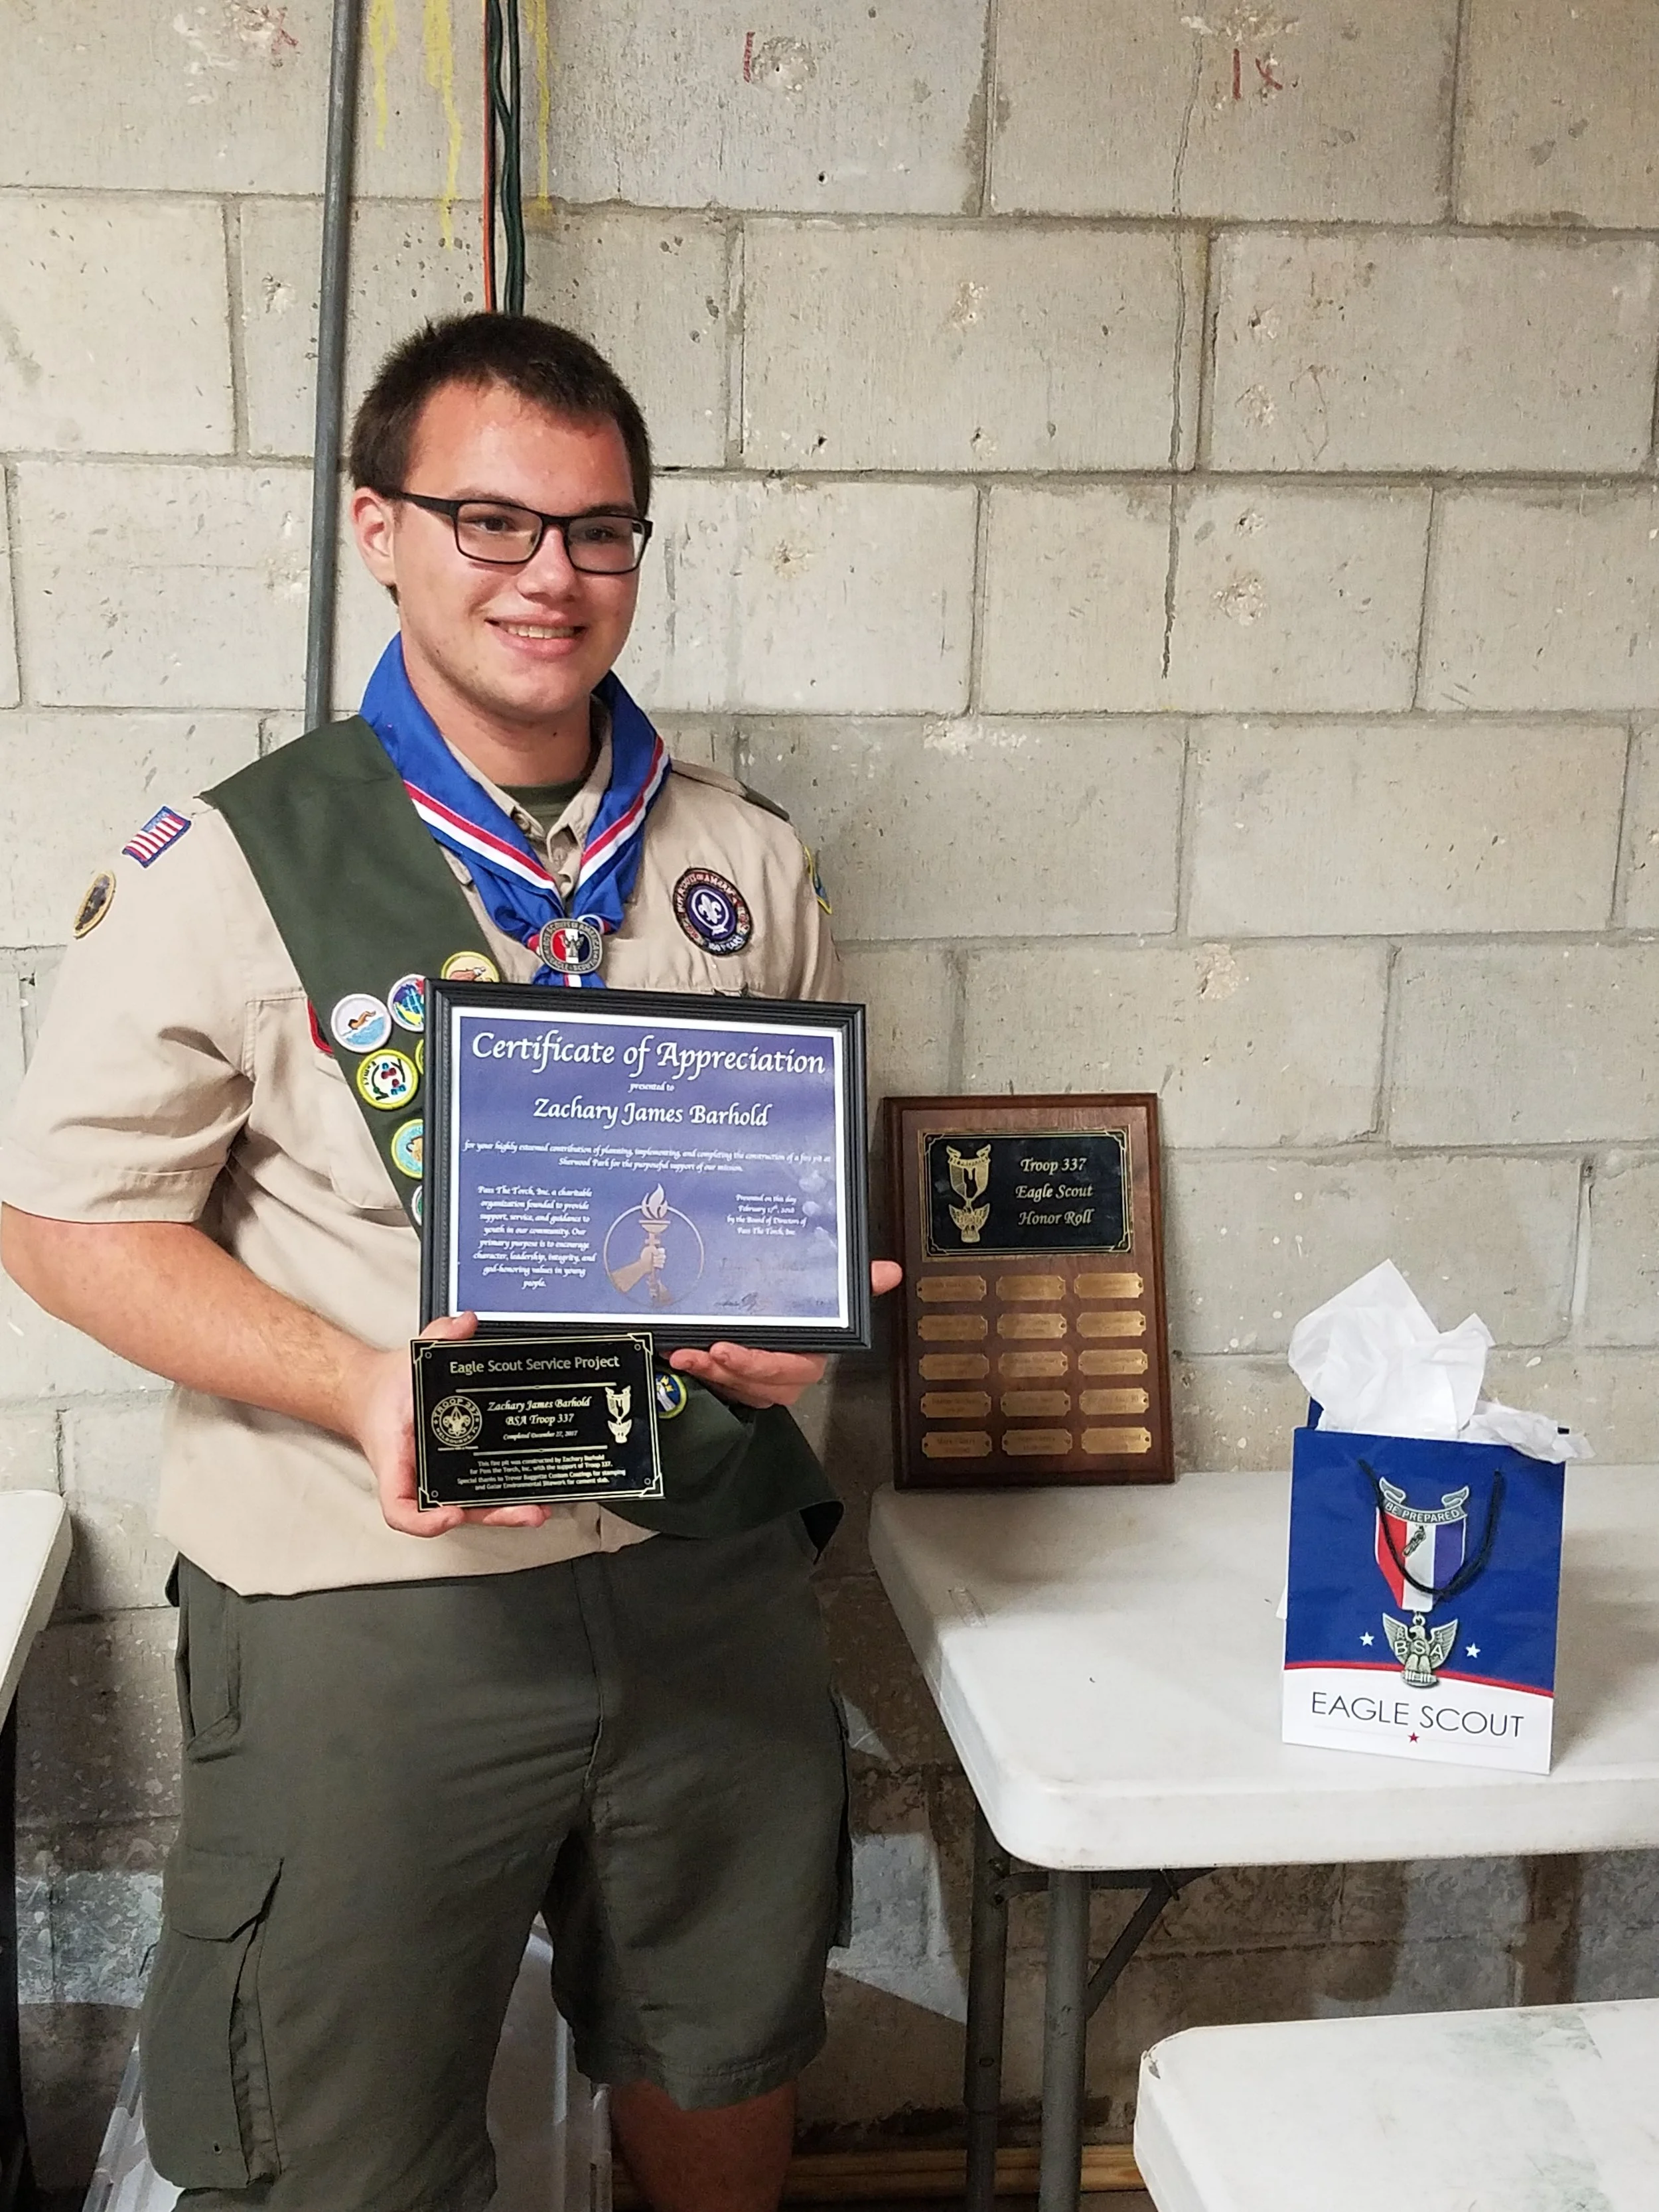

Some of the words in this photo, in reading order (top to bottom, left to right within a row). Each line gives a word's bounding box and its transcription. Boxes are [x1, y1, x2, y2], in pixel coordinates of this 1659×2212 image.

[472, 1029, 614, 1073] Certificate
[623, 1035, 654, 1078] of
[656, 1042, 826, 1080] Appreciation
[628, 1081, 666, 1094] presented
[666, 1083, 675, 1092] to
[533, 1095, 618, 1129] Zachary
[621, 1102, 684, 1125] James
[689, 1102, 773, 1126] Barhold
[463, 1140, 474, 1151] for
[476, 1142, 493, 1152] your
[494, 1140, 518, 1153] highly
[549, 1143, 592, 1153] contribution
[593, 1144, 601, 1156] of
[682, 1148, 697, 1158] and
[697, 1149, 733, 1161] completing
[733, 1149, 744, 1159] the
[558, 1157, 592, 1166] Sherwood
[592, 1158, 609, 1167] Park
[609, 1157, 621, 1170] for
[622, 1159, 632, 1168] the
[670, 1163, 695, 1173] support
[696, 1162, 704, 1173] of
[1020, 1158, 1058, 1175] Troop
[1061, 1157, 1087, 1171] 337
[496, 1185, 510, 1195] The
[557, 1187, 593, 1197] charitable
[1015, 1183, 1052, 1203] Eagle
[1056, 1183, 1094, 1199] Scout
[480, 1200, 526, 1210] organization
[525, 1199, 555, 1211] founded
[562, 1201, 589, 1212] provide
[785, 1195, 796, 1205] day
[738, 1205, 766, 1215] February
[1018, 1211, 1062, 1226] Honor
[1064, 1209, 1095, 1225] Roll
[535, 1213, 551, 1221] and
[549, 1213, 581, 1224] guidance
[727, 1215, 735, 1225] by
[766, 1216, 772, 1226] of
[800, 1217, 808, 1228] of
[483, 1224, 506, 1236] youth
[478, 1240, 510, 1249] primary
[509, 1240, 538, 1249] purpose
[555, 1241, 589, 1252] encourage
[581, 1253, 597, 1262] and
[482, 1264, 530, 1276] god-honoring
[532, 1265, 553, 1274] values
[563, 1268, 586, 1278] young
[450, 1361, 484, 1376] Eagle
[488, 1360, 523, 1372] Scout
[526, 1358, 571, 1370] Service
[575, 1356, 620, 1370] Project
[433, 1398, 463, 1418] TROOP
[465, 1402, 480, 1416] 337
[486, 1400, 525, 1412] Zachary
[526, 1400, 553, 1411] James
[554, 1396, 592, 1408] Barhold
[505, 1416, 527, 1426] BSA
[529, 1414, 555, 1426] Troop
[557, 1413, 574, 1423] 337
[503, 1432, 531, 1441] Completed
[1384, 1502, 1398, 1514] BE
[1402, 1509, 1460, 1522] PREPARED
[1394, 1640, 1444, 1660] BSA
[1312, 1691, 1410, 1726] EAGLE
[1419, 1706, 1524, 1737] SCOUT
